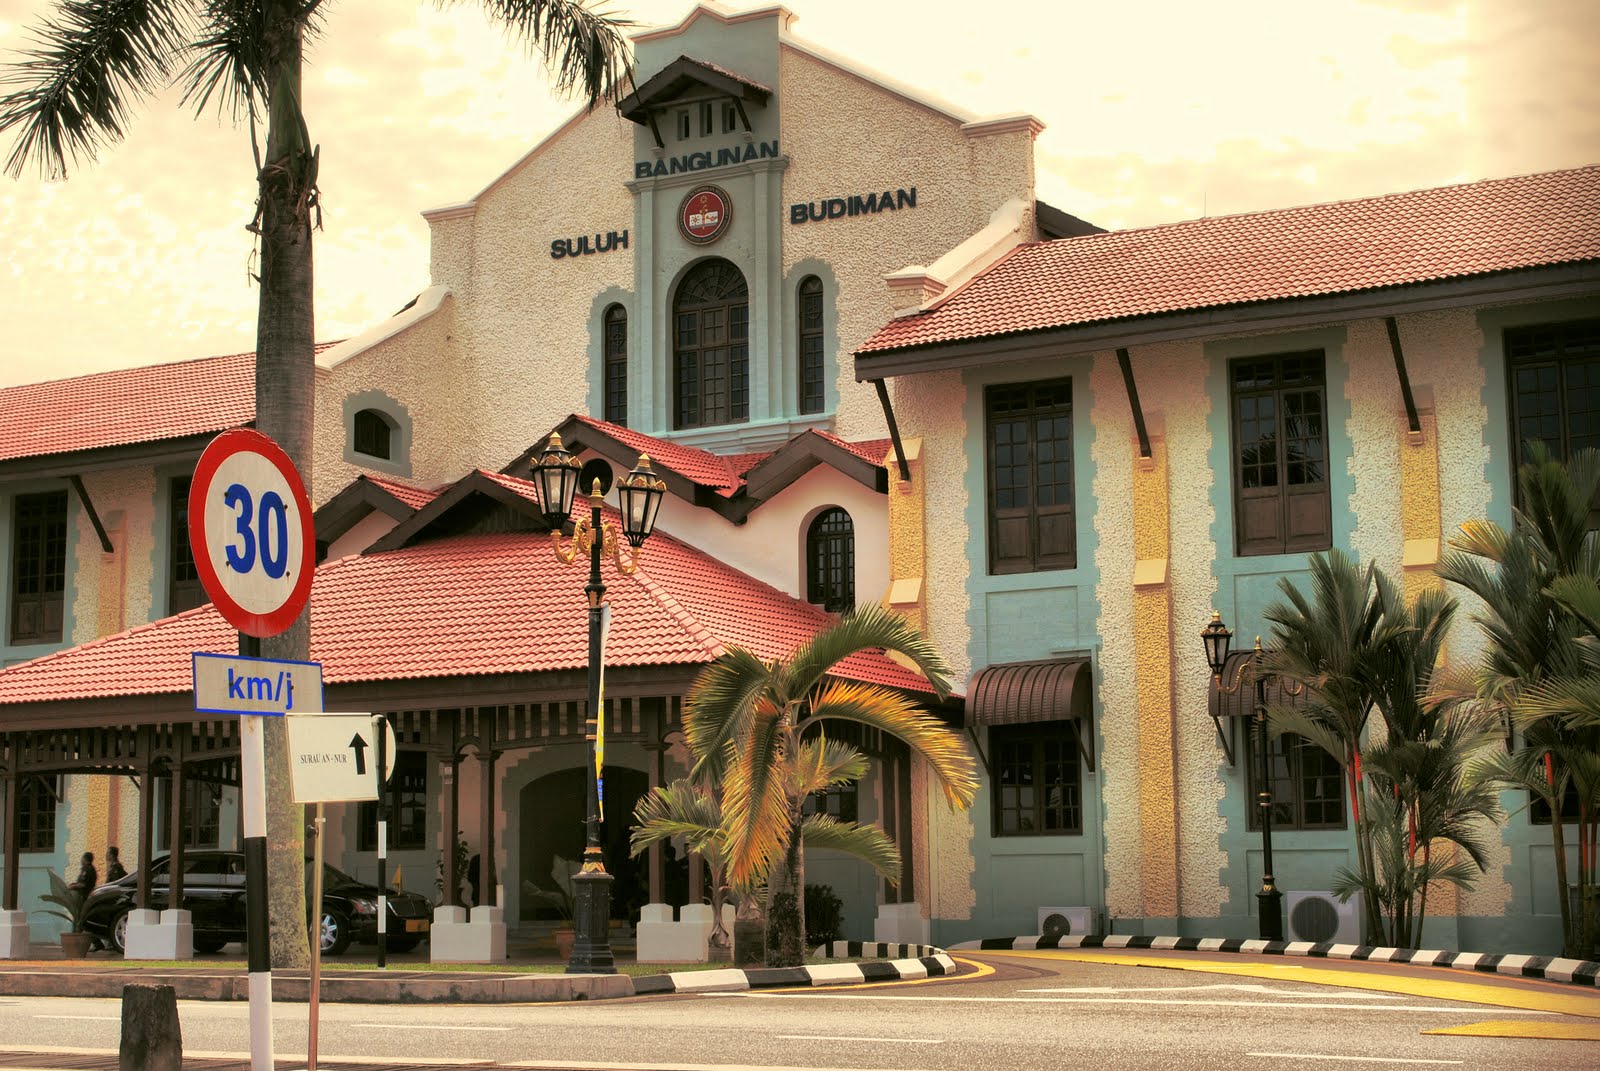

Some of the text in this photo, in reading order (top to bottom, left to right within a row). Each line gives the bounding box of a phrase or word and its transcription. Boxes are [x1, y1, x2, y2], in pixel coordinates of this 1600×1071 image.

[635, 140, 779, 179] BANGUNAN
[790, 187, 917, 225] BUDIMAN
[550, 229, 629, 259] SULUH
[224, 484, 288, 580] 30
[228, 668, 293, 709] km/j
[300, 754, 320, 764] SURAU
